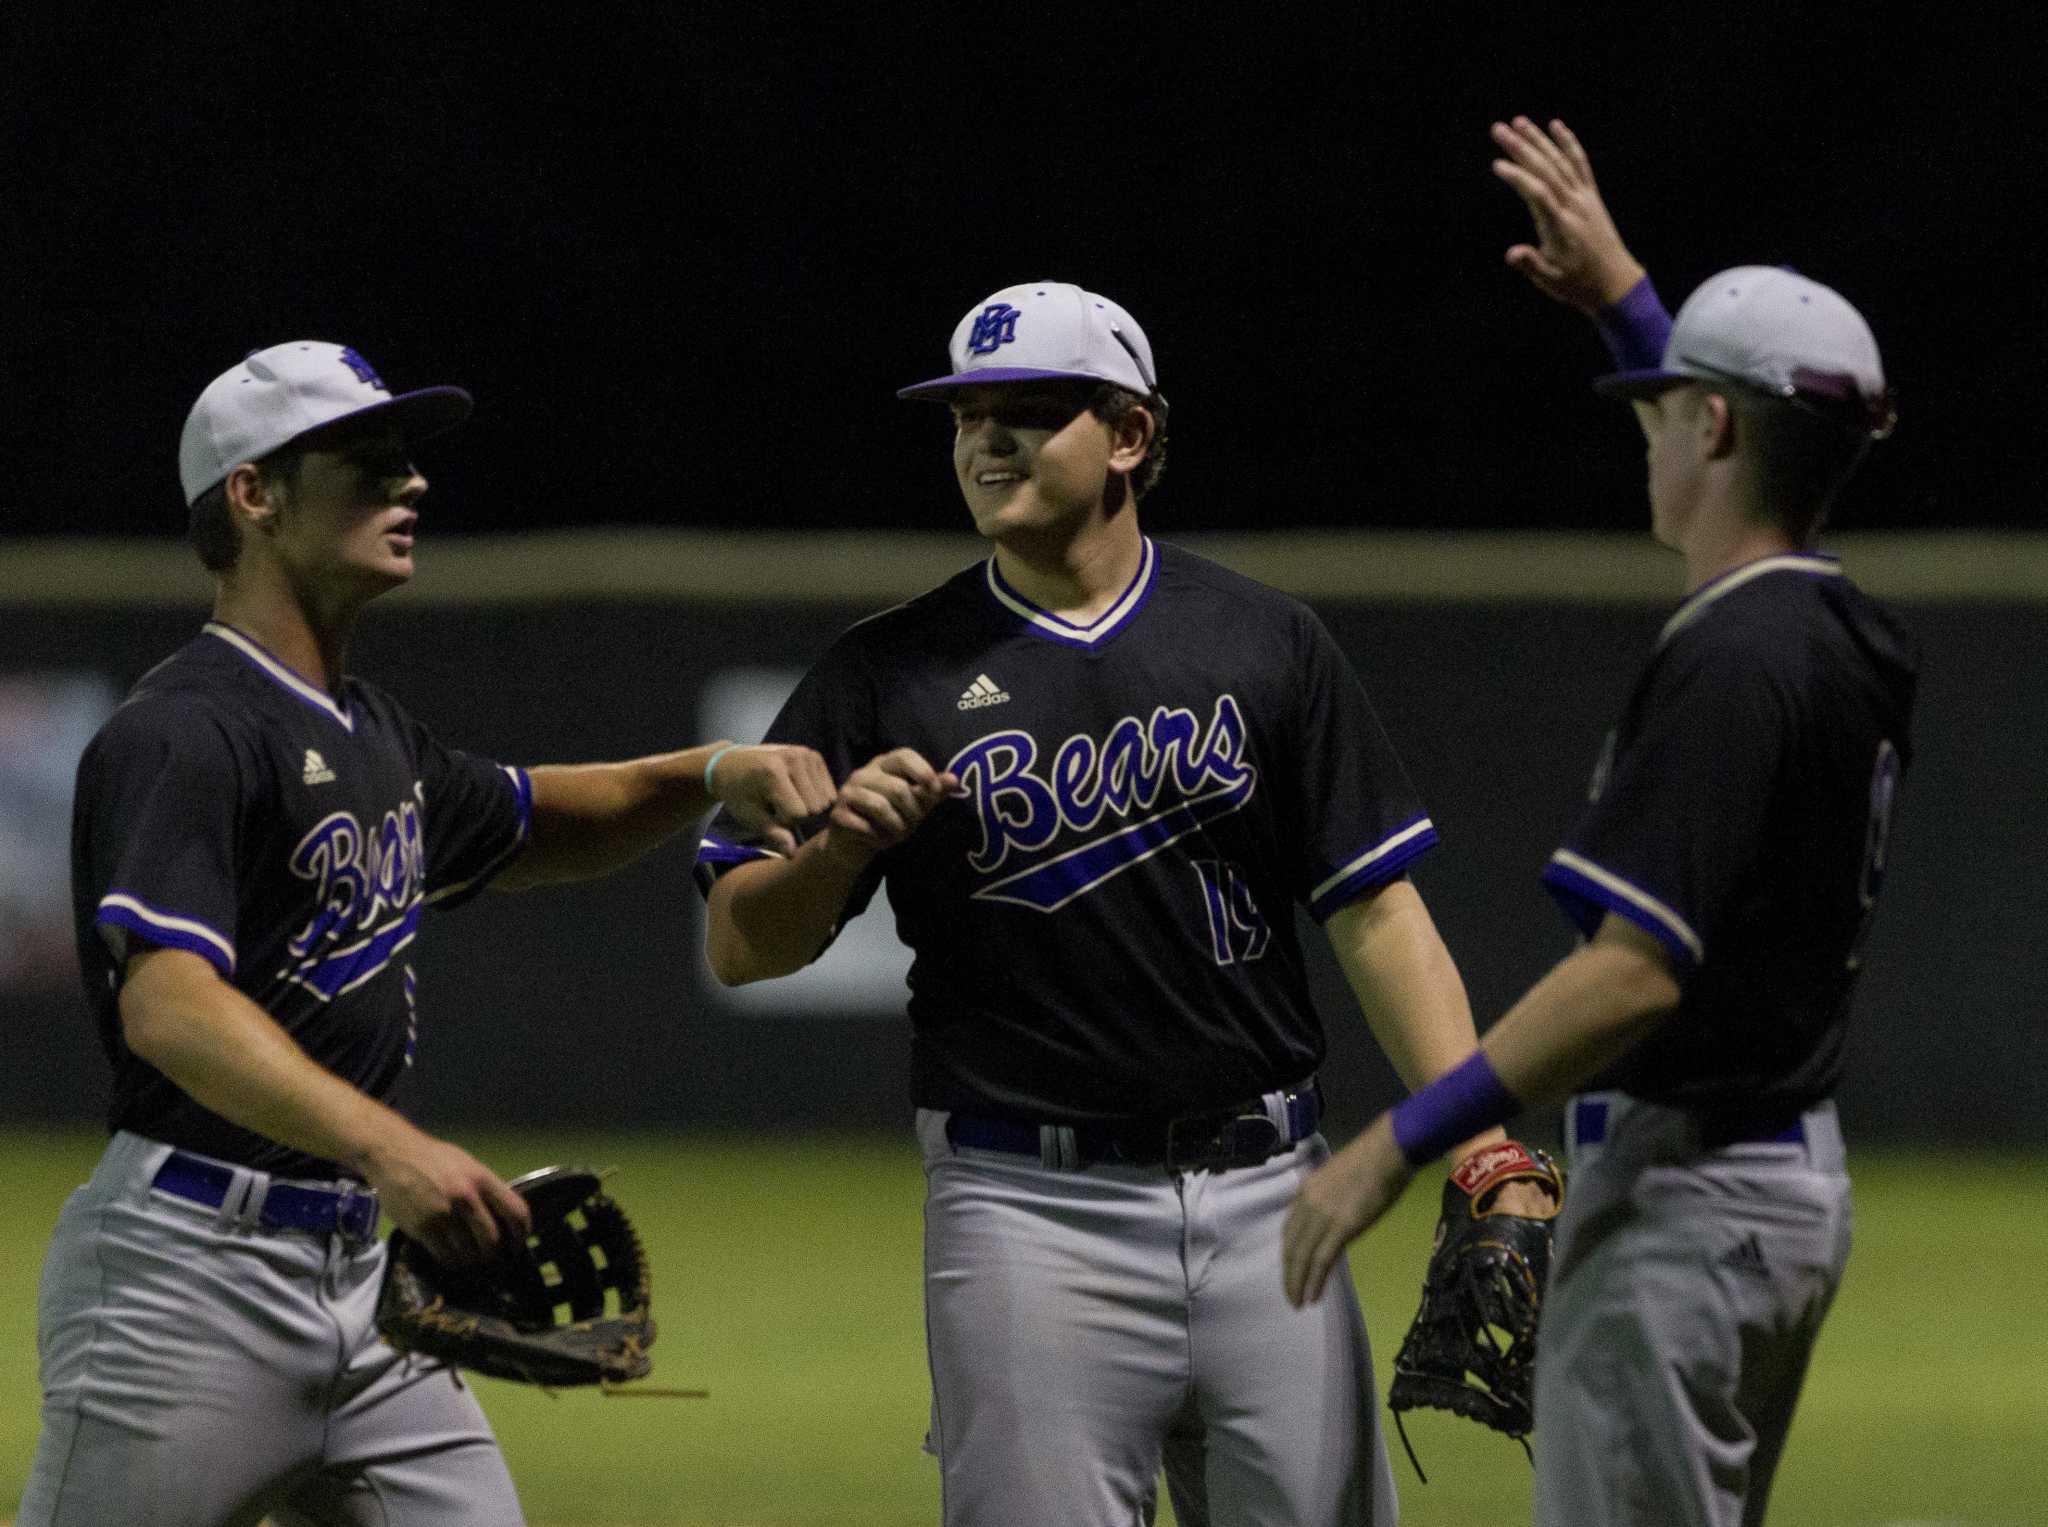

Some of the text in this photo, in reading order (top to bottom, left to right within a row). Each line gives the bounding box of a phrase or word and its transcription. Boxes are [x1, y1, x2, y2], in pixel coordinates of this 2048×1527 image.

[957, 691, 1010, 710] adidas
[947, 694, 1256, 873] Bears
[1190, 859, 1271, 966] 19
